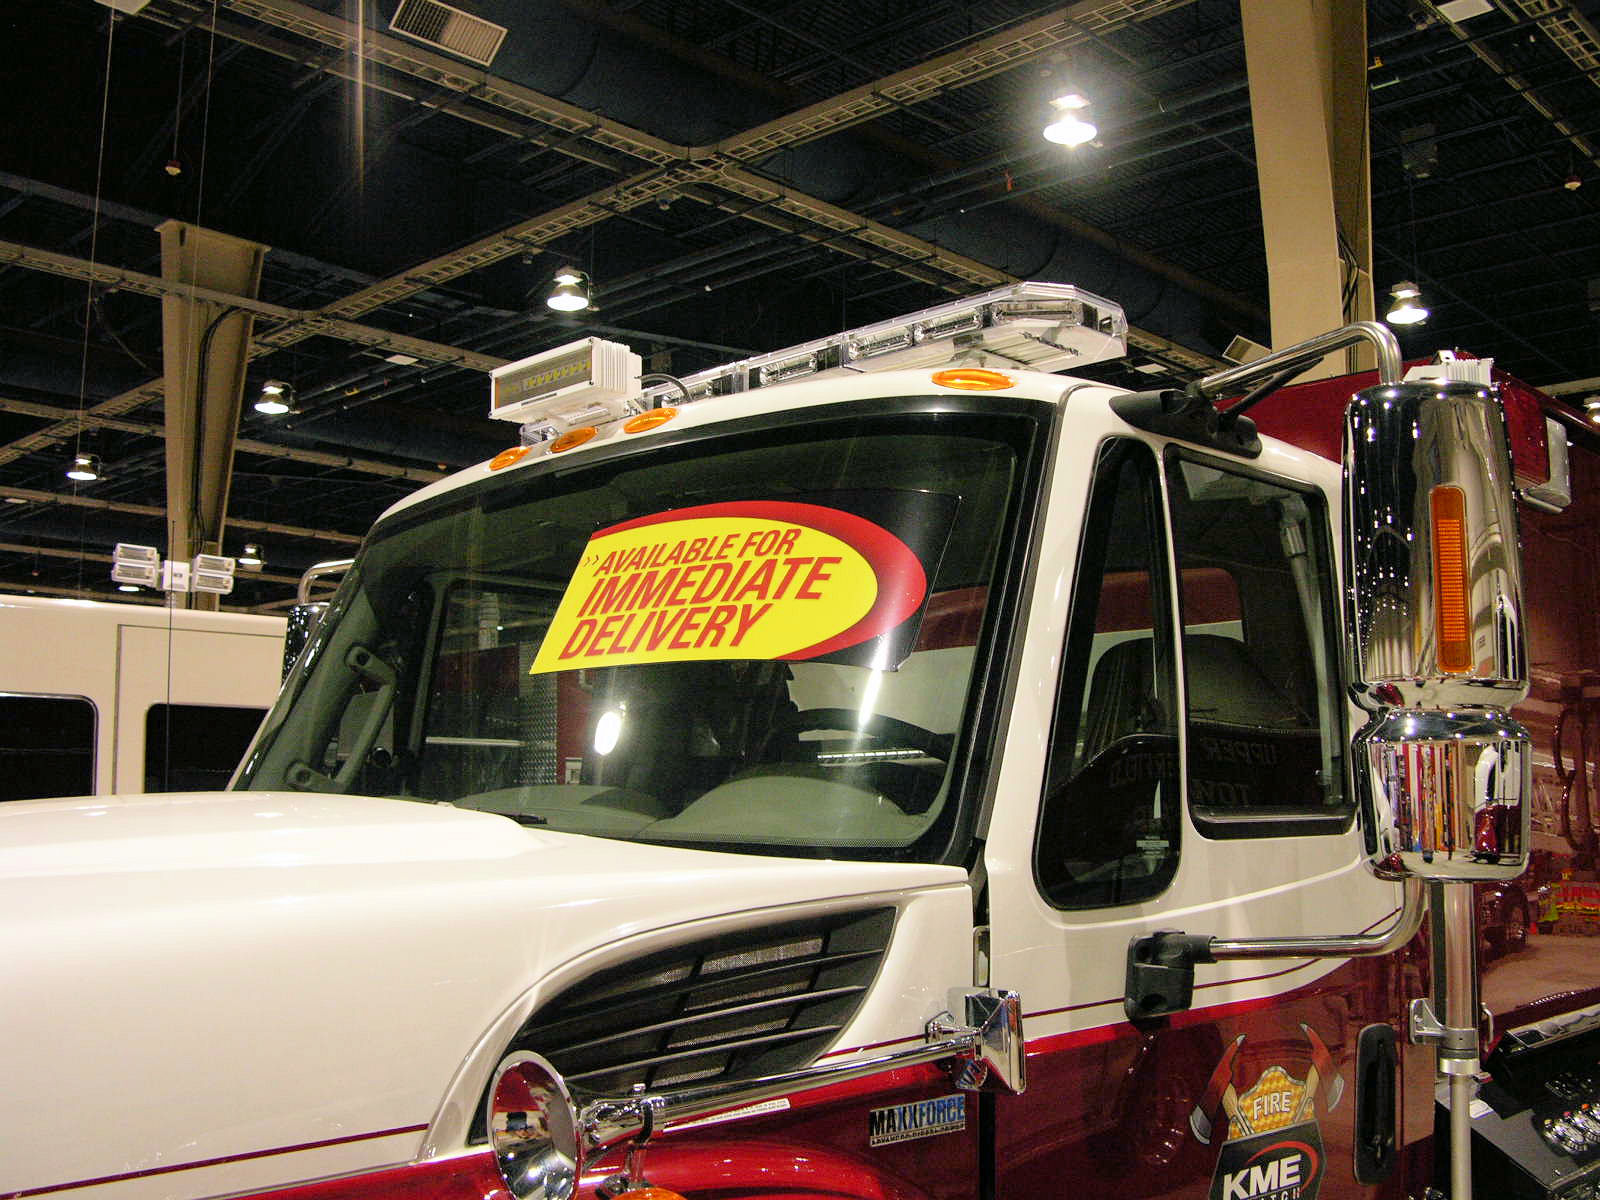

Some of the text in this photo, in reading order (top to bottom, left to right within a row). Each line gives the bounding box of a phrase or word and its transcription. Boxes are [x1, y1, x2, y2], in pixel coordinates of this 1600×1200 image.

[592, 529, 802, 577] AVAILABLE FOR
[576, 557, 842, 617] IMMEDIATE
[558, 603, 773, 659] DELIVERY
[869, 1096, 964, 1136] MAXXFORCE
[1254, 1091, 1292, 1120] FIRE
[1223, 1153, 1301, 1200] KME
